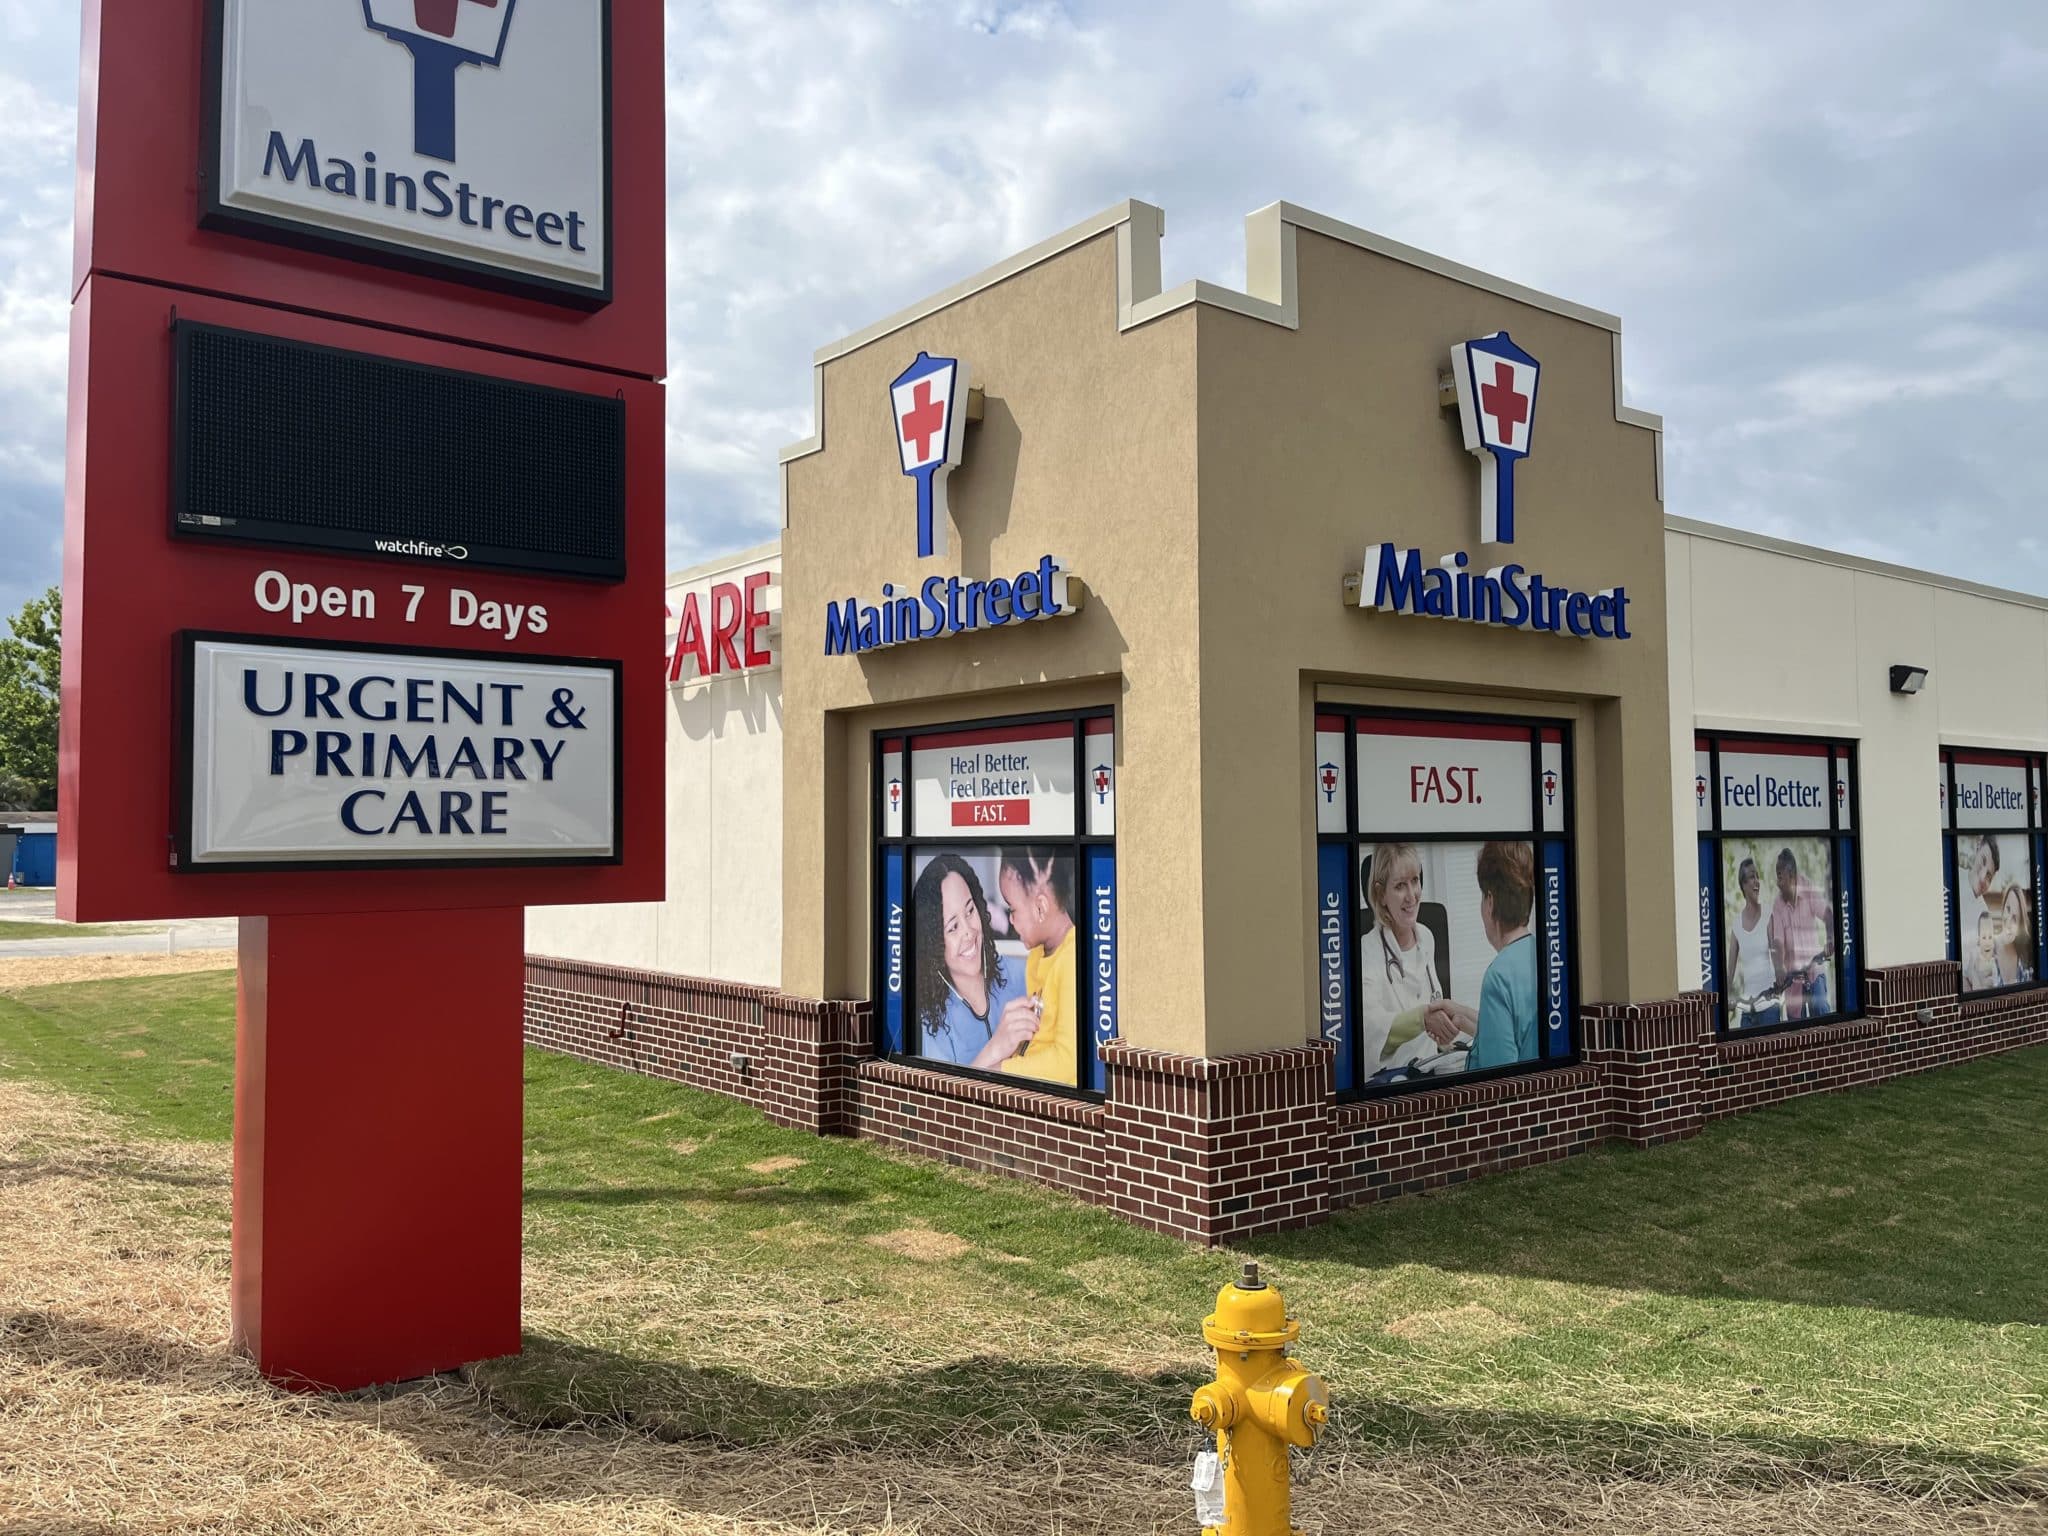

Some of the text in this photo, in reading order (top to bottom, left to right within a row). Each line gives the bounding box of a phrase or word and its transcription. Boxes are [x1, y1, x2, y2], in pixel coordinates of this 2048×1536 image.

[262, 130, 586, 252] MainStreet
[375, 540, 443, 557] watchfire
[254, 570, 549, 640] Open 7 Days
[824, 555, 1064, 656] MainStreet
[1375, 542, 1631, 640] MainStreet
[665, 571, 771, 682] ARE
[243, 669, 588, 729] URGENT &
[269, 729, 566, 780] PRIMARY
[951, 753, 1029, 775] Heal Better.
[951, 777, 1029, 798] Feel Better.
[1410, 765, 1482, 804] FAST.
[340, 789, 508, 835] CARE
[974, 804, 1007, 822] FAST.
[1724, 774, 1822, 808] Feel Better.
[1955, 781, 2024, 810] Heal Better.
[887, 903, 903, 993] Quality
[1543, 867, 1562, 1031] Occupational
[1700, 886, 1712, 984] Wellness
[1841, 889, 1852, 956] Sports
[1094, 885, 1112, 1047] Convenient
[1322, 892, 1342, 1042] Affordable
